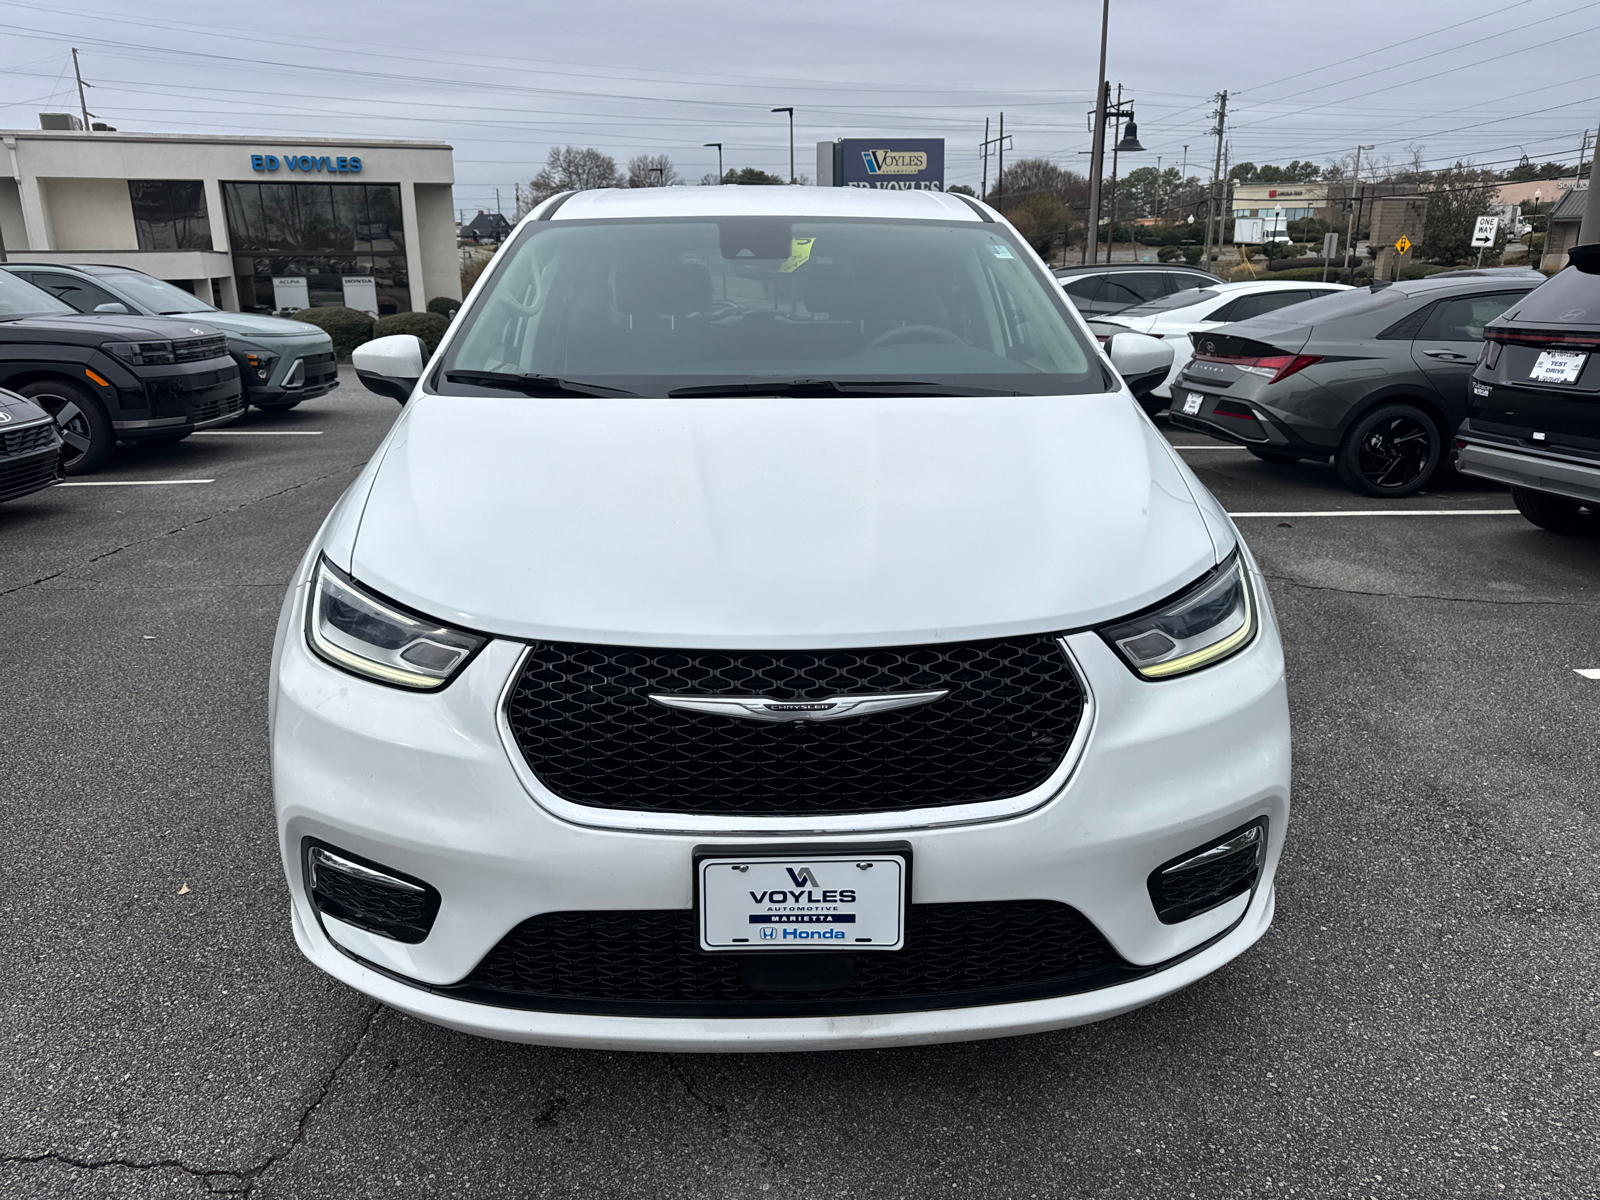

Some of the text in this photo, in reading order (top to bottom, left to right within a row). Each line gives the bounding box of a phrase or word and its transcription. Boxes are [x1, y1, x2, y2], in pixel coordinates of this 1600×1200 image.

[251, 154, 363, 173] ED VOYLES
[871, 150, 924, 171] VOYLES
[1479, 218, 1496, 226] ONE
[1478, 226, 1495, 234] WAY
[1544, 367, 1566, 375] DRIVE
[749, 889, 857, 904] VOYLES
[782, 927, 846, 939] Honda
